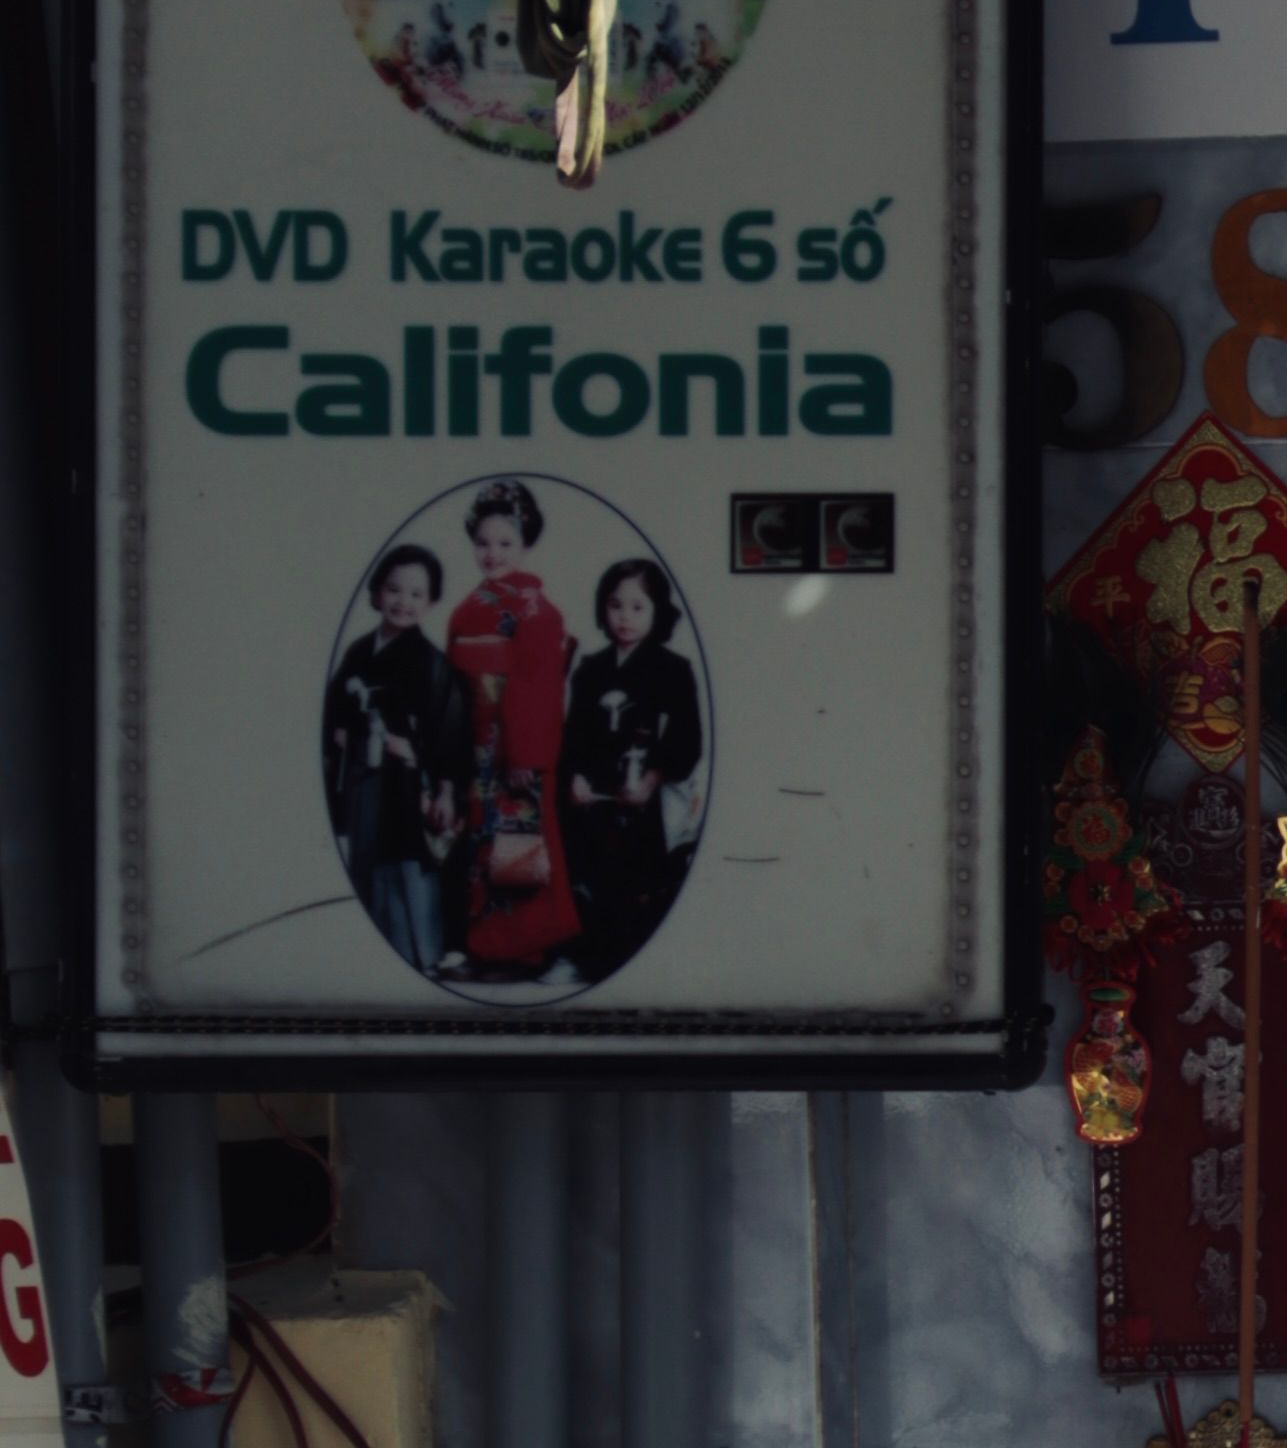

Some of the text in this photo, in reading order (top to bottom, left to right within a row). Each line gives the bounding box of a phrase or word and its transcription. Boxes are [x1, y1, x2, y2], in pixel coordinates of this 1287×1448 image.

[181, 196, 895, 283] DVD Karaoke 6 số
[185, 325, 896, 437] Califonia
[1089, 574, 1131, 617] 平
